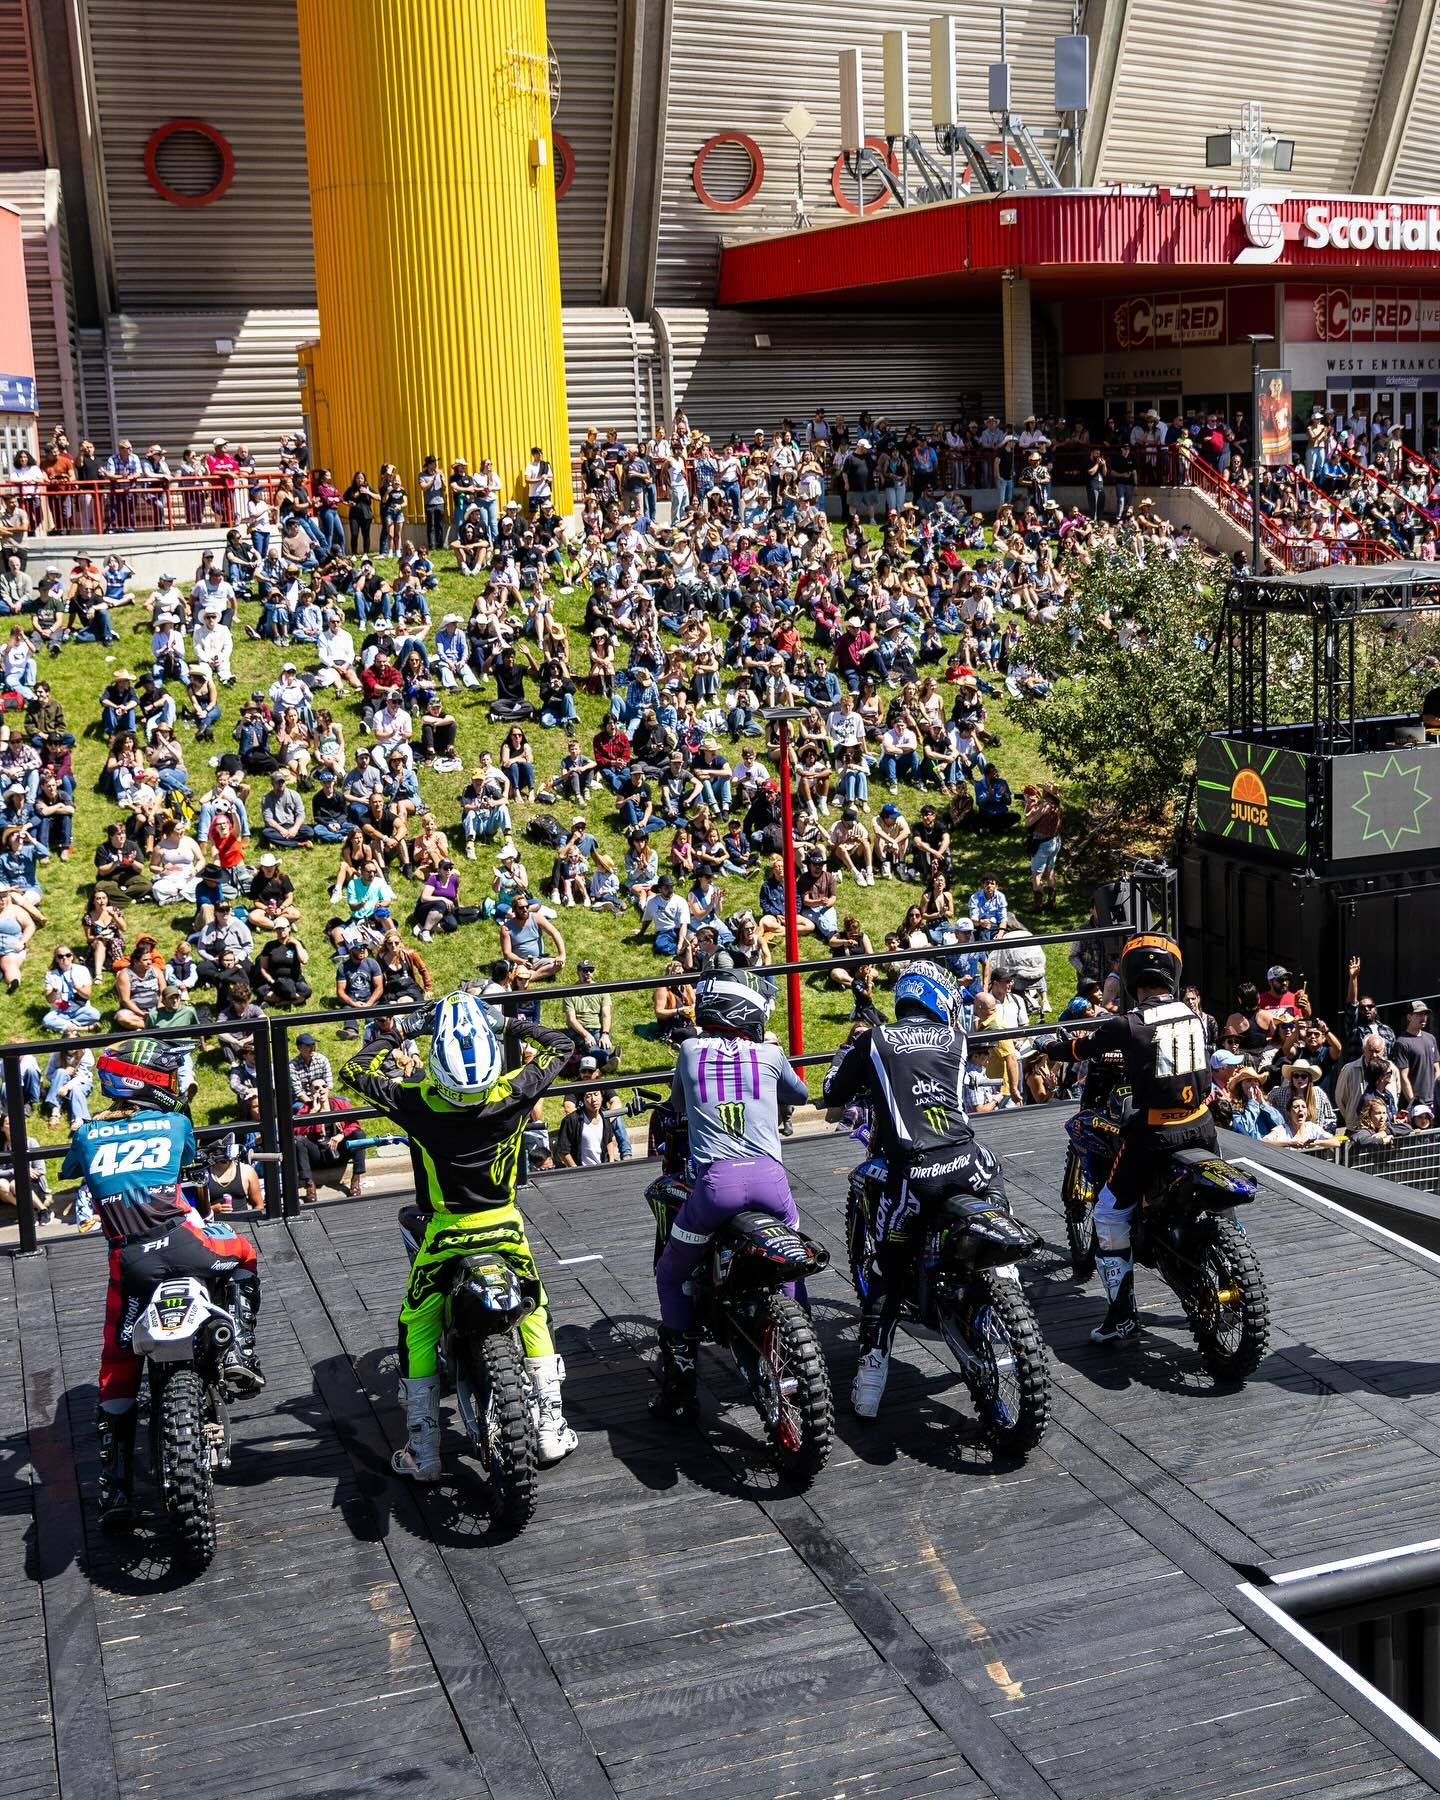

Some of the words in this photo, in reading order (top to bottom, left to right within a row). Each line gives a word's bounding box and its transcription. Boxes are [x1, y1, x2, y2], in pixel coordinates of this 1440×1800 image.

[1152, 311, 1173, 329] OF
[1176, 306, 1219, 330] RED
[1352, 307, 1371, 323] OF
[1375, 304, 1412, 327] RED
[1327, 359, 1364, 371] WEST
[1152, 1018, 1207, 1078] 111
[124, 1065, 163, 1084] HAVOC
[125, 1077, 141, 1087] BELL
[87, 1119, 171, 1140] GOLDEN
[90, 1136, 172, 1178] 423
[1106, 1267, 1122, 1279] FOX
